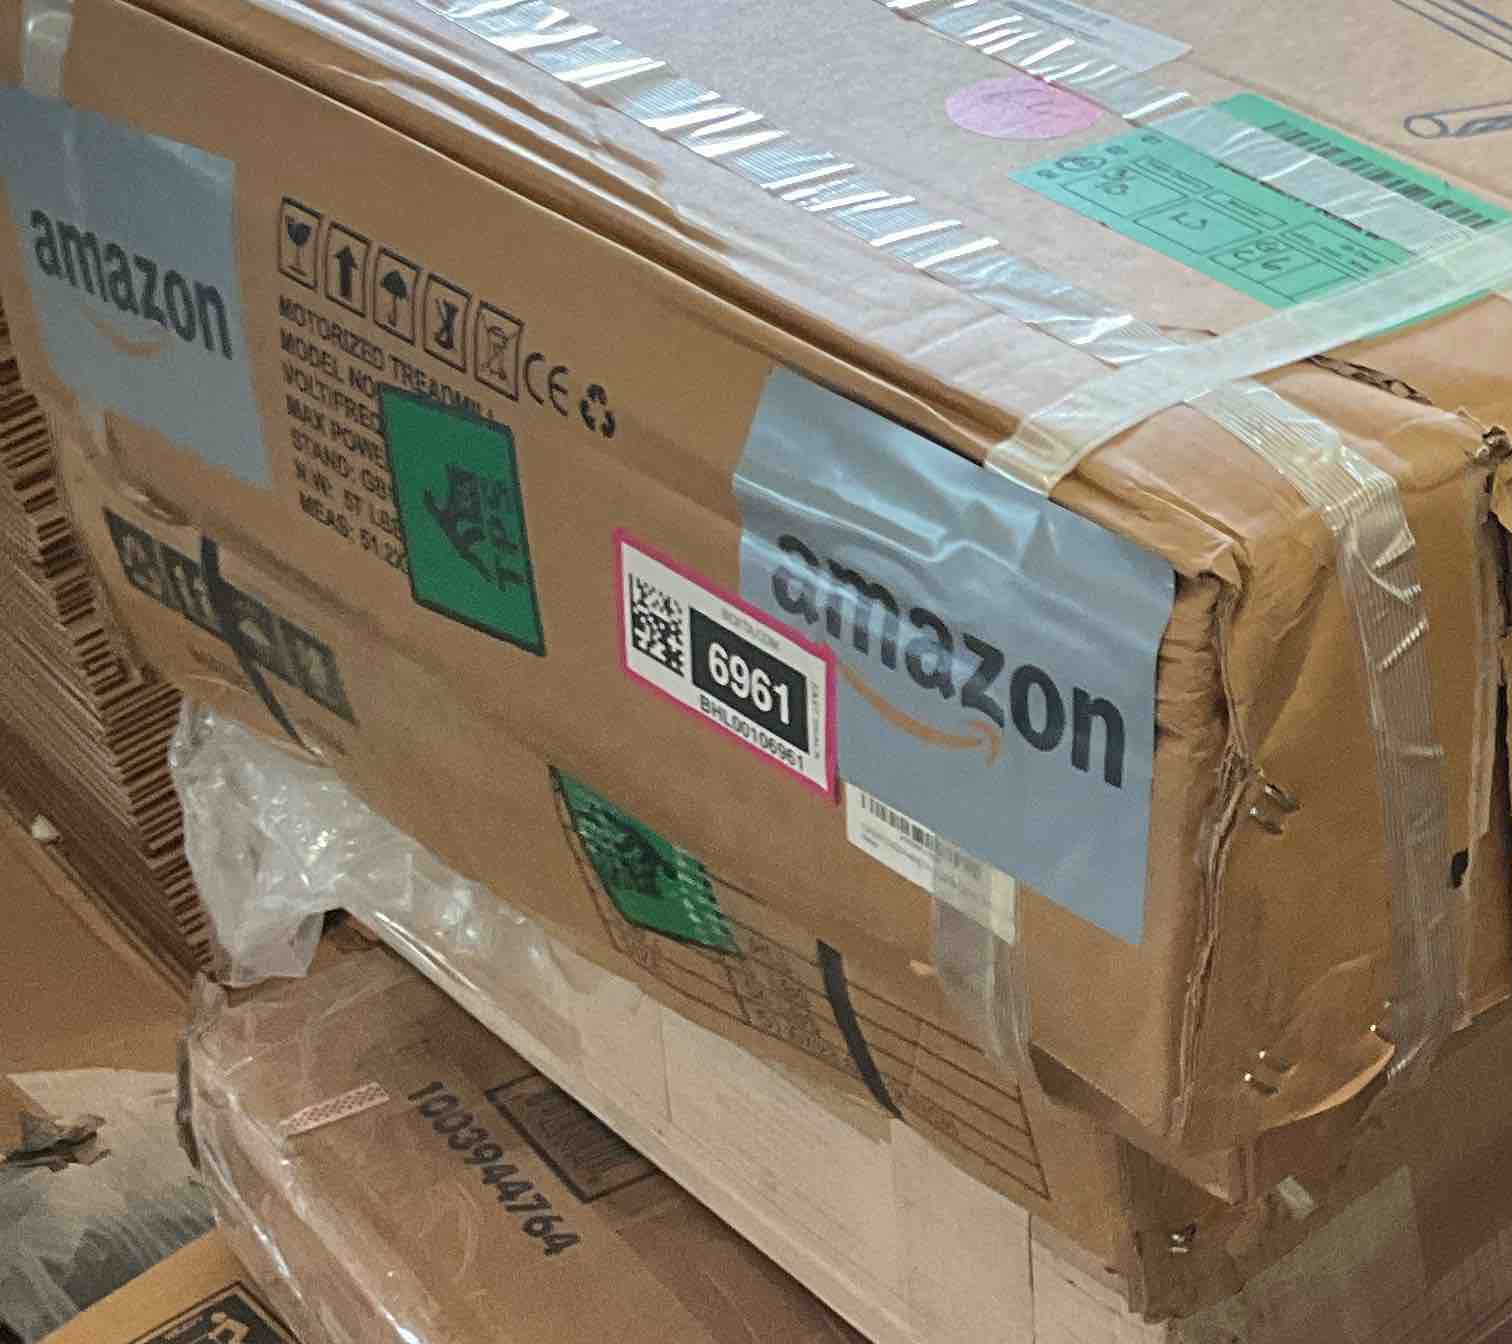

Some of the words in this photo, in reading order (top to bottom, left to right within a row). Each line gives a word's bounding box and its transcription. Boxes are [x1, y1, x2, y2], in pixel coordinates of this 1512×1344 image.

[31, 209, 233, 361] amazon
[279, 294, 386, 372] MOTORIZED
[388, 354, 494, 420] TREAD
[280, 326, 345, 383] MODEL
[525, 351, 570, 418] CE
[330, 420, 392, 472] POWE
[709, 642, 790, 724] 6961
[770, 534, 1126, 789] amazon
[700, 692, 805, 772] BHL00106961
